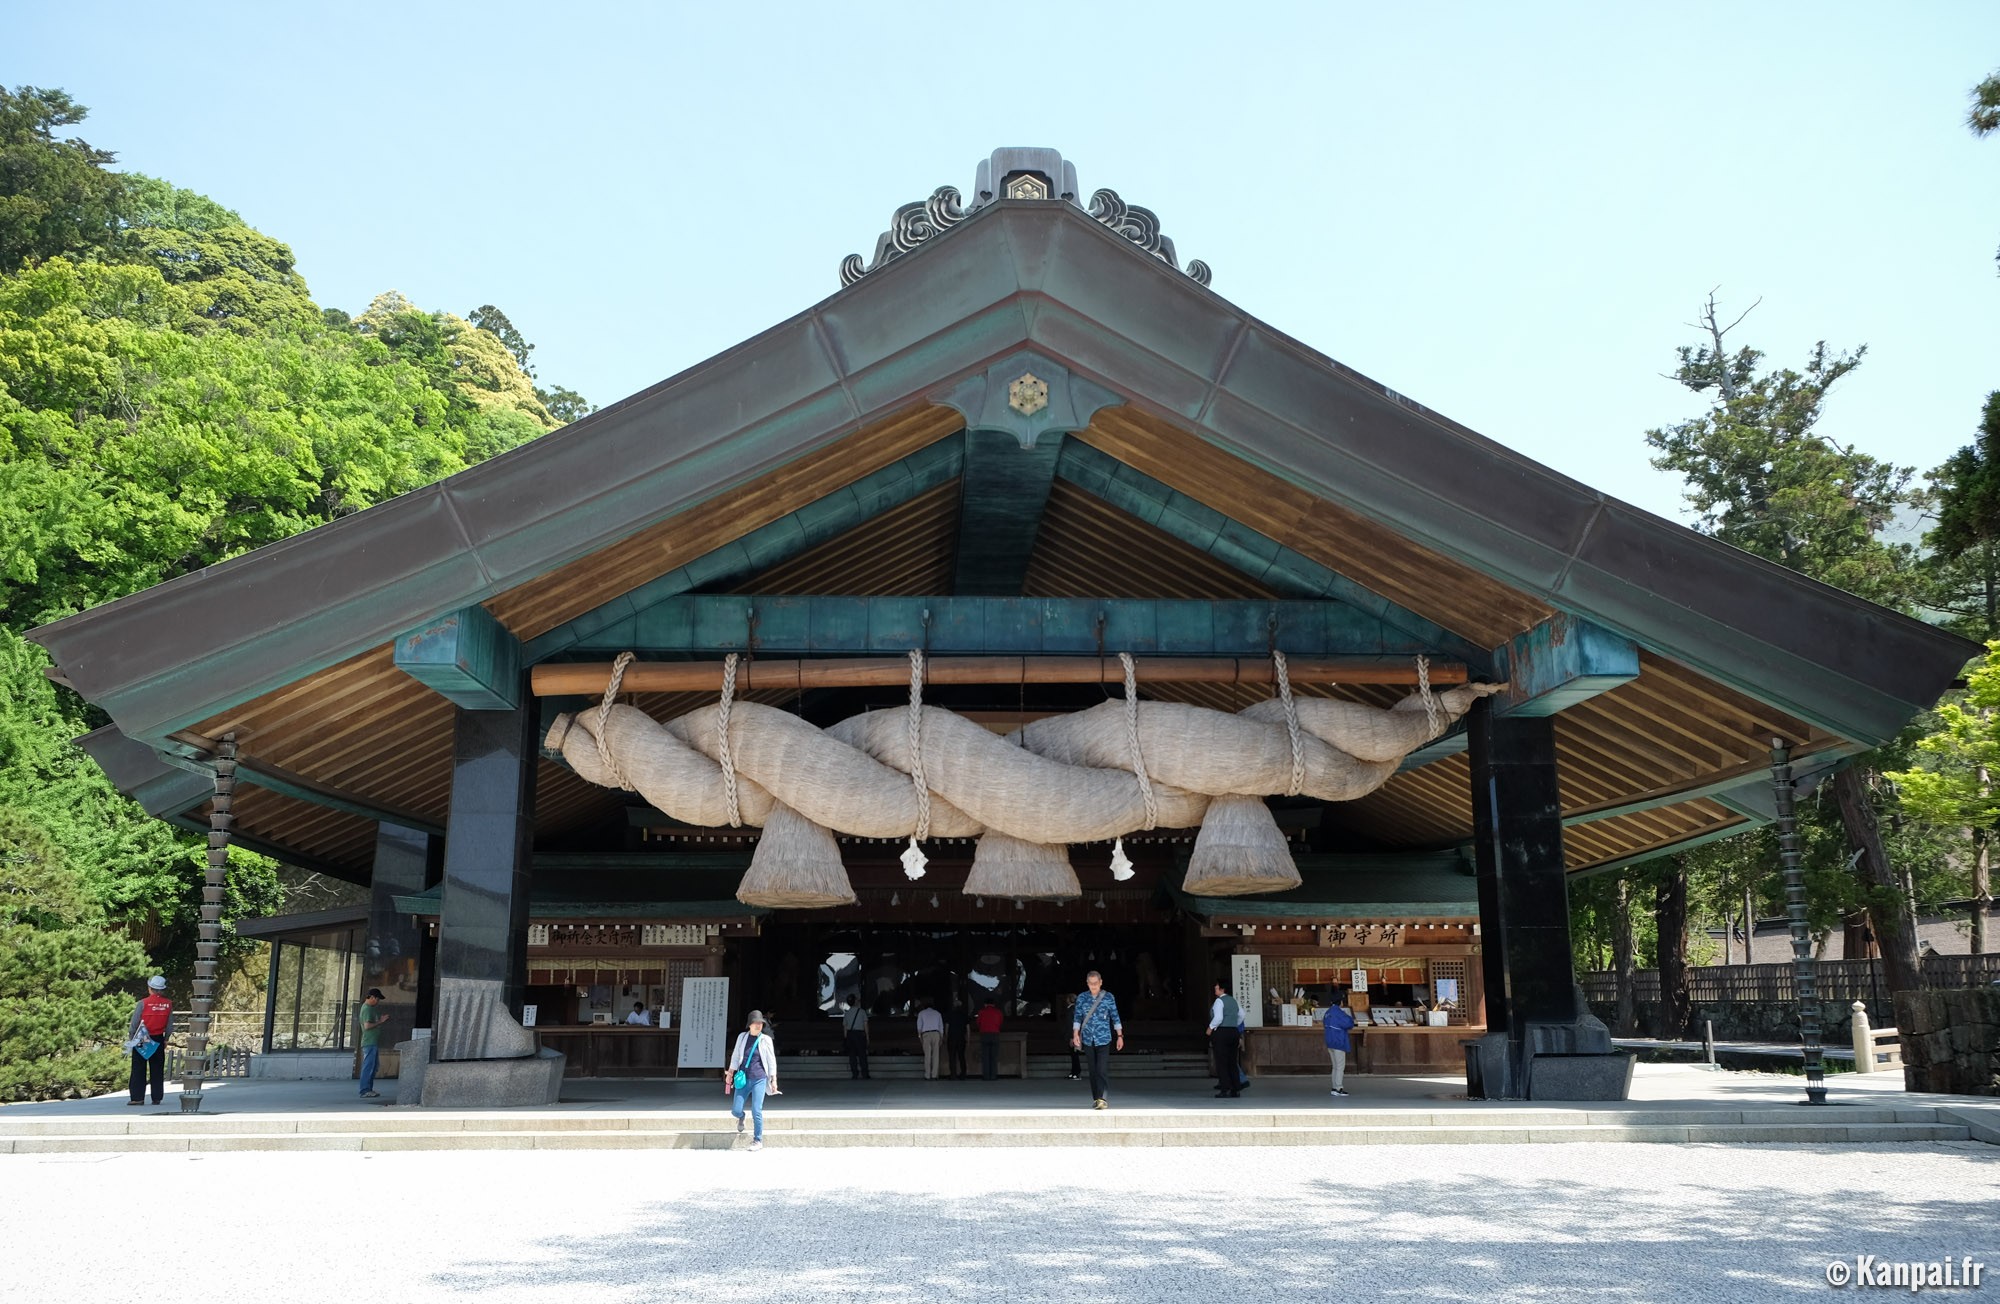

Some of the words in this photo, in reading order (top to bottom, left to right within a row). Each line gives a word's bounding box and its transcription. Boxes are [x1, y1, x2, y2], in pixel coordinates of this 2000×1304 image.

[552, 930, 633, 945] 御祈念受付所
[1327, 928, 1398, 945] 御守所
